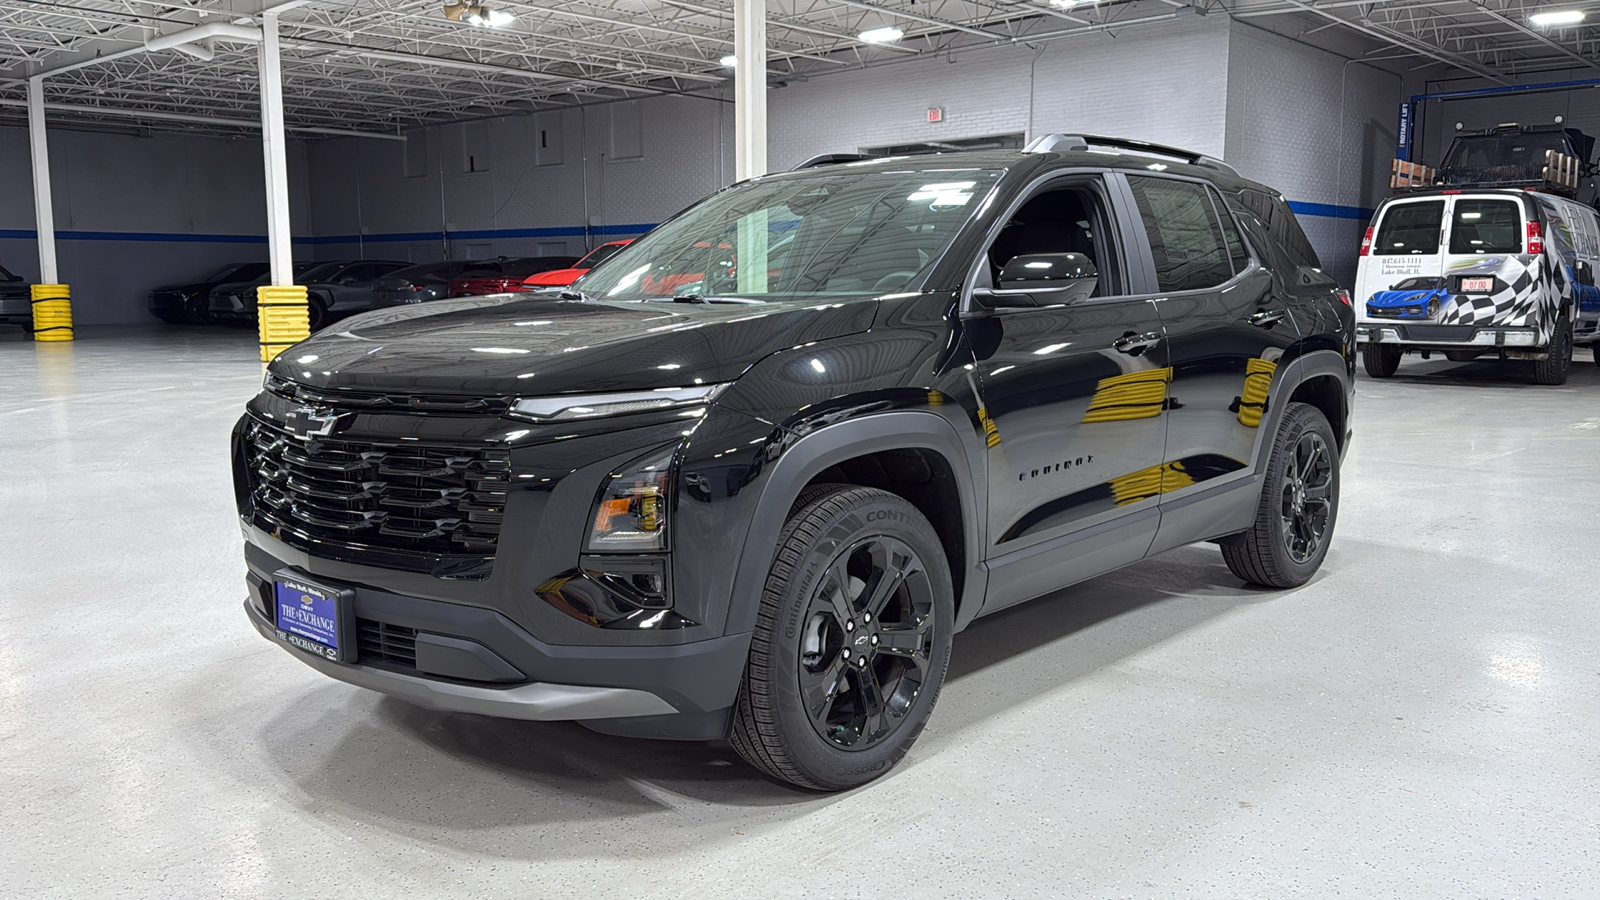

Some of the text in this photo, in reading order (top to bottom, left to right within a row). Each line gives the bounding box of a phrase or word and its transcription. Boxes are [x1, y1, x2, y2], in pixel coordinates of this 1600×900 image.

[1399, 118, 1407, 145] ROTARY
[1019, 455, 1094, 481] EQUINOX
[784, 568, 815, 639] Continental
[281, 604, 335, 633] THE EXCHANGE
[275, 630, 324, 656] THE EXCHANGE
